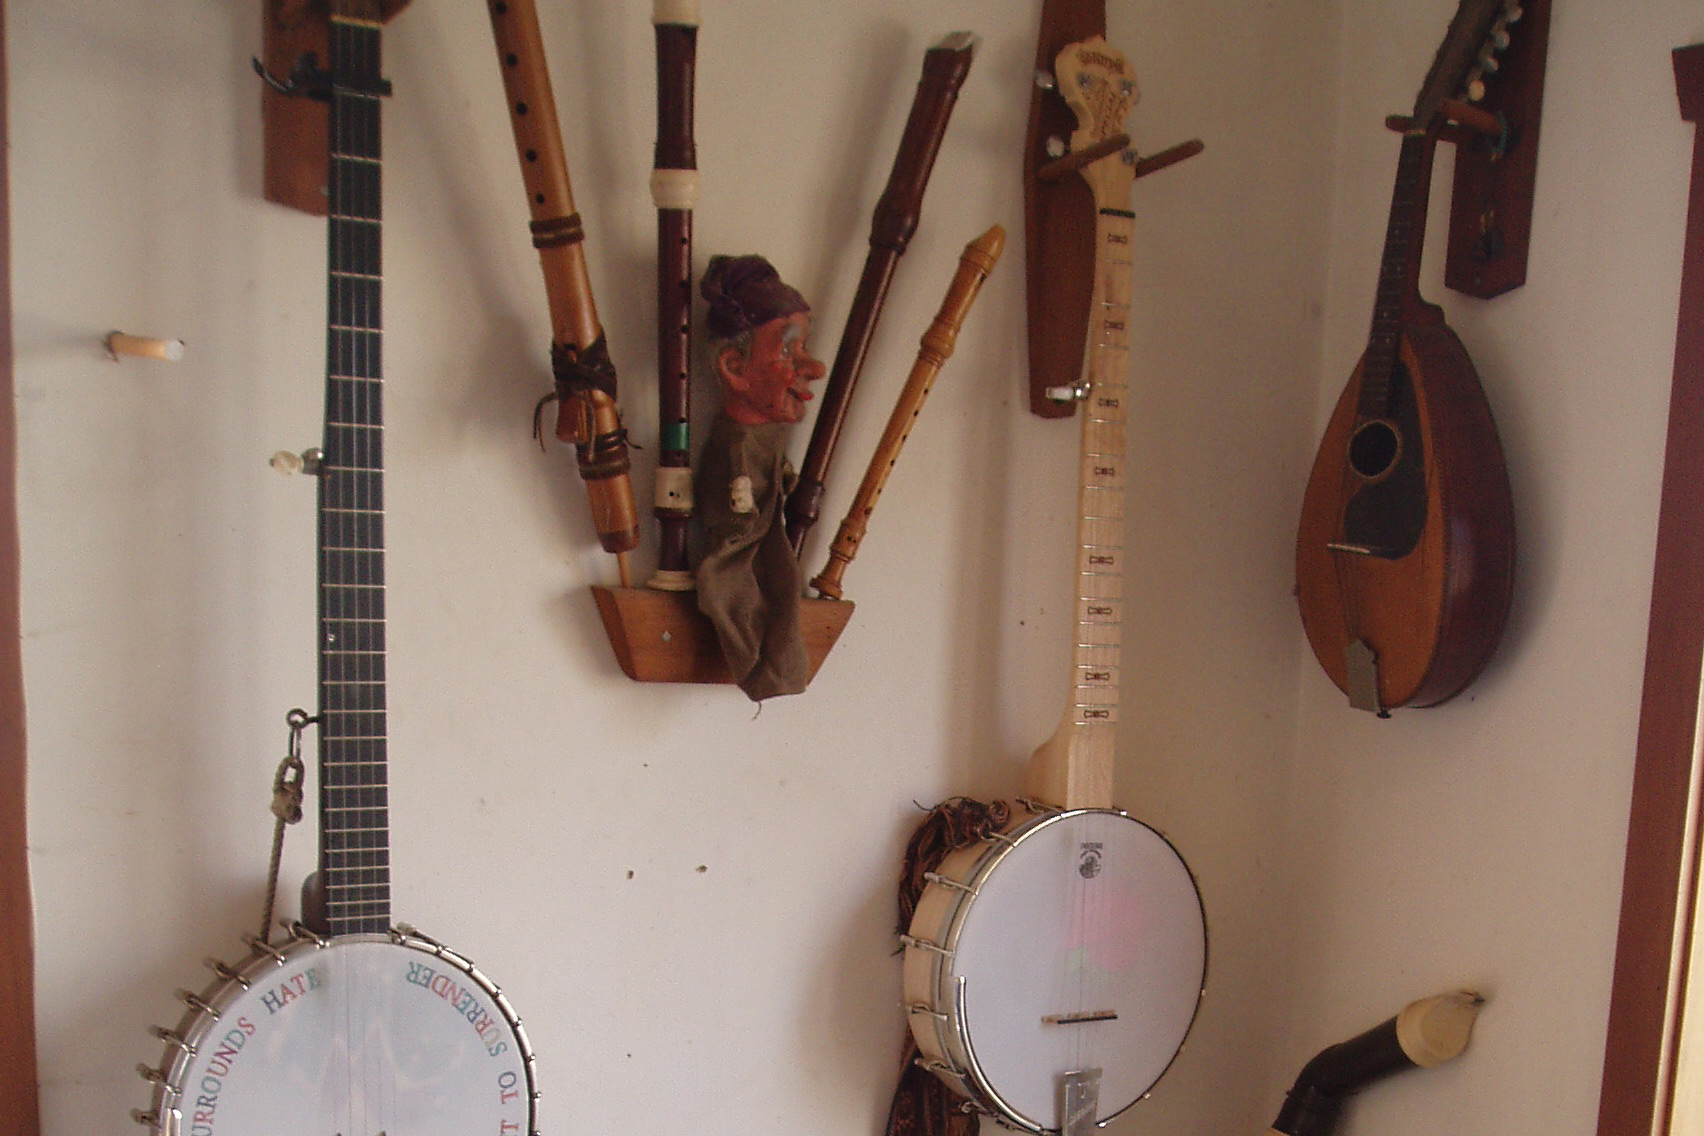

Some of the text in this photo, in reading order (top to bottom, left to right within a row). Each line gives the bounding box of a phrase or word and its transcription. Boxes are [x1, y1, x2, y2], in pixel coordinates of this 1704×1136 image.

[260, 968, 322, 1015] HATE
[406, 961, 508, 1057] SURRENDER
[498, 1071, 518, 1104] TO
